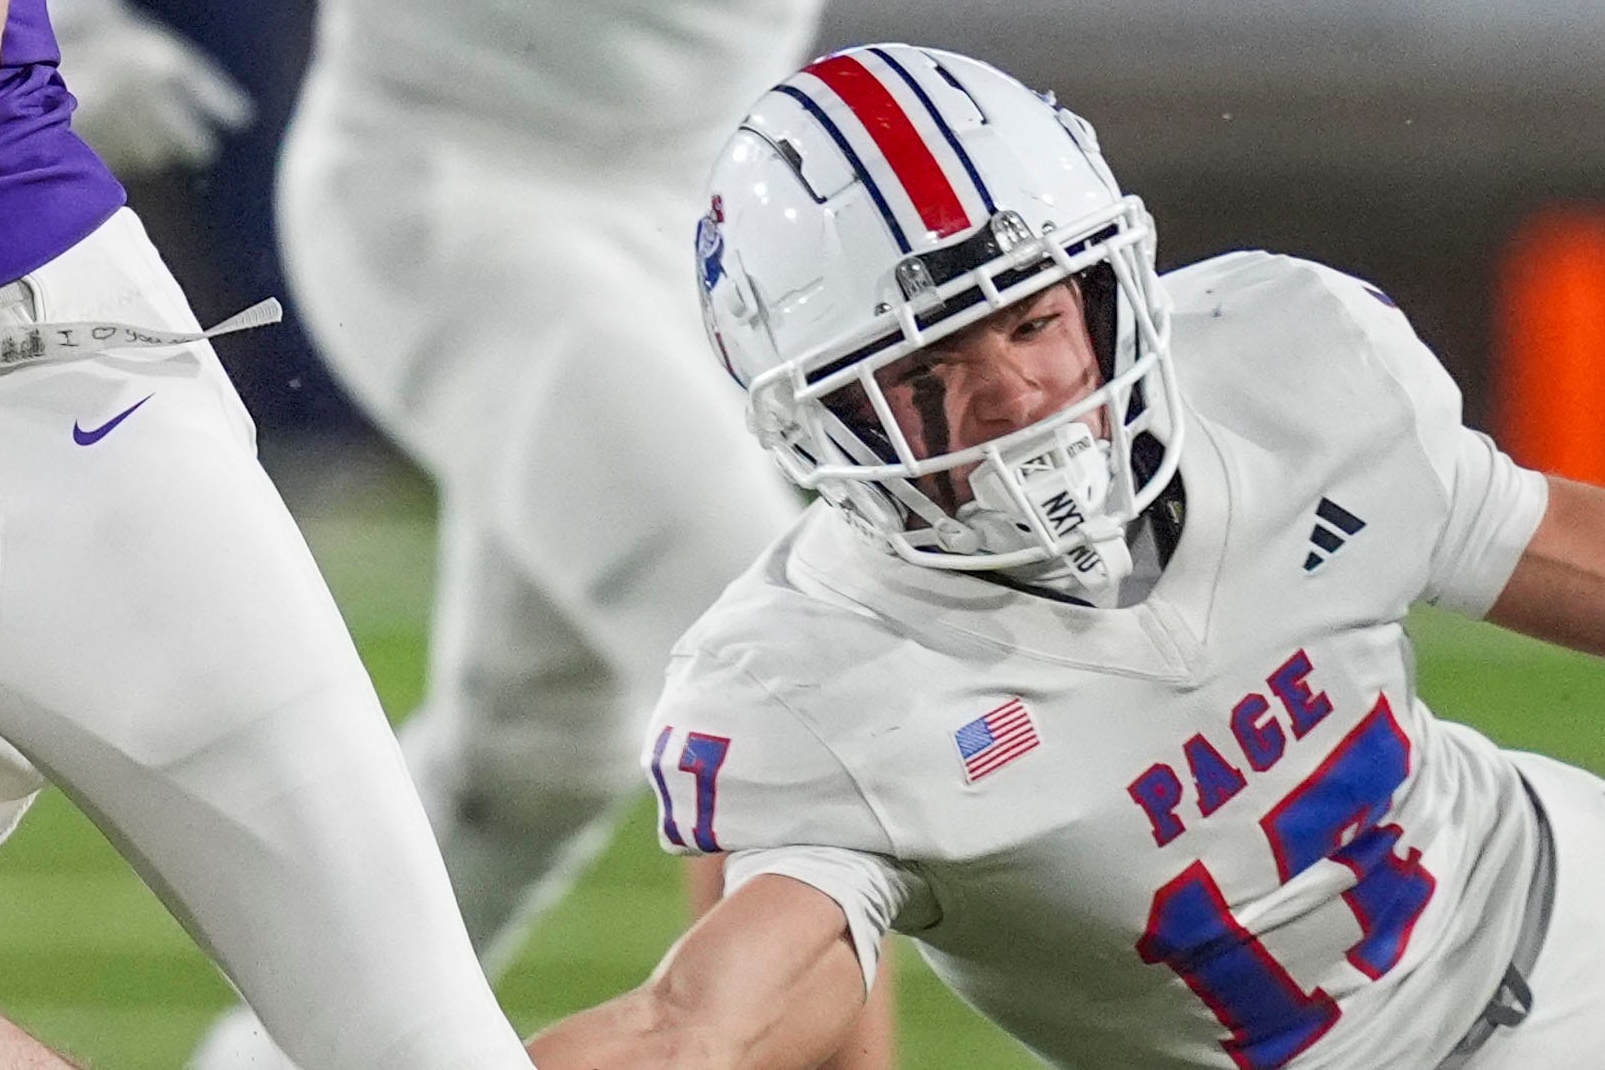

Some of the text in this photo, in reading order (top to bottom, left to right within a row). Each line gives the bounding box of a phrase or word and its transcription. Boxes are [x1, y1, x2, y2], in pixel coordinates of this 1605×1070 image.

[651, 725, 731, 853] 17
[1127, 648, 1334, 848] PAGE
[1135, 690, 1437, 1070] 17
